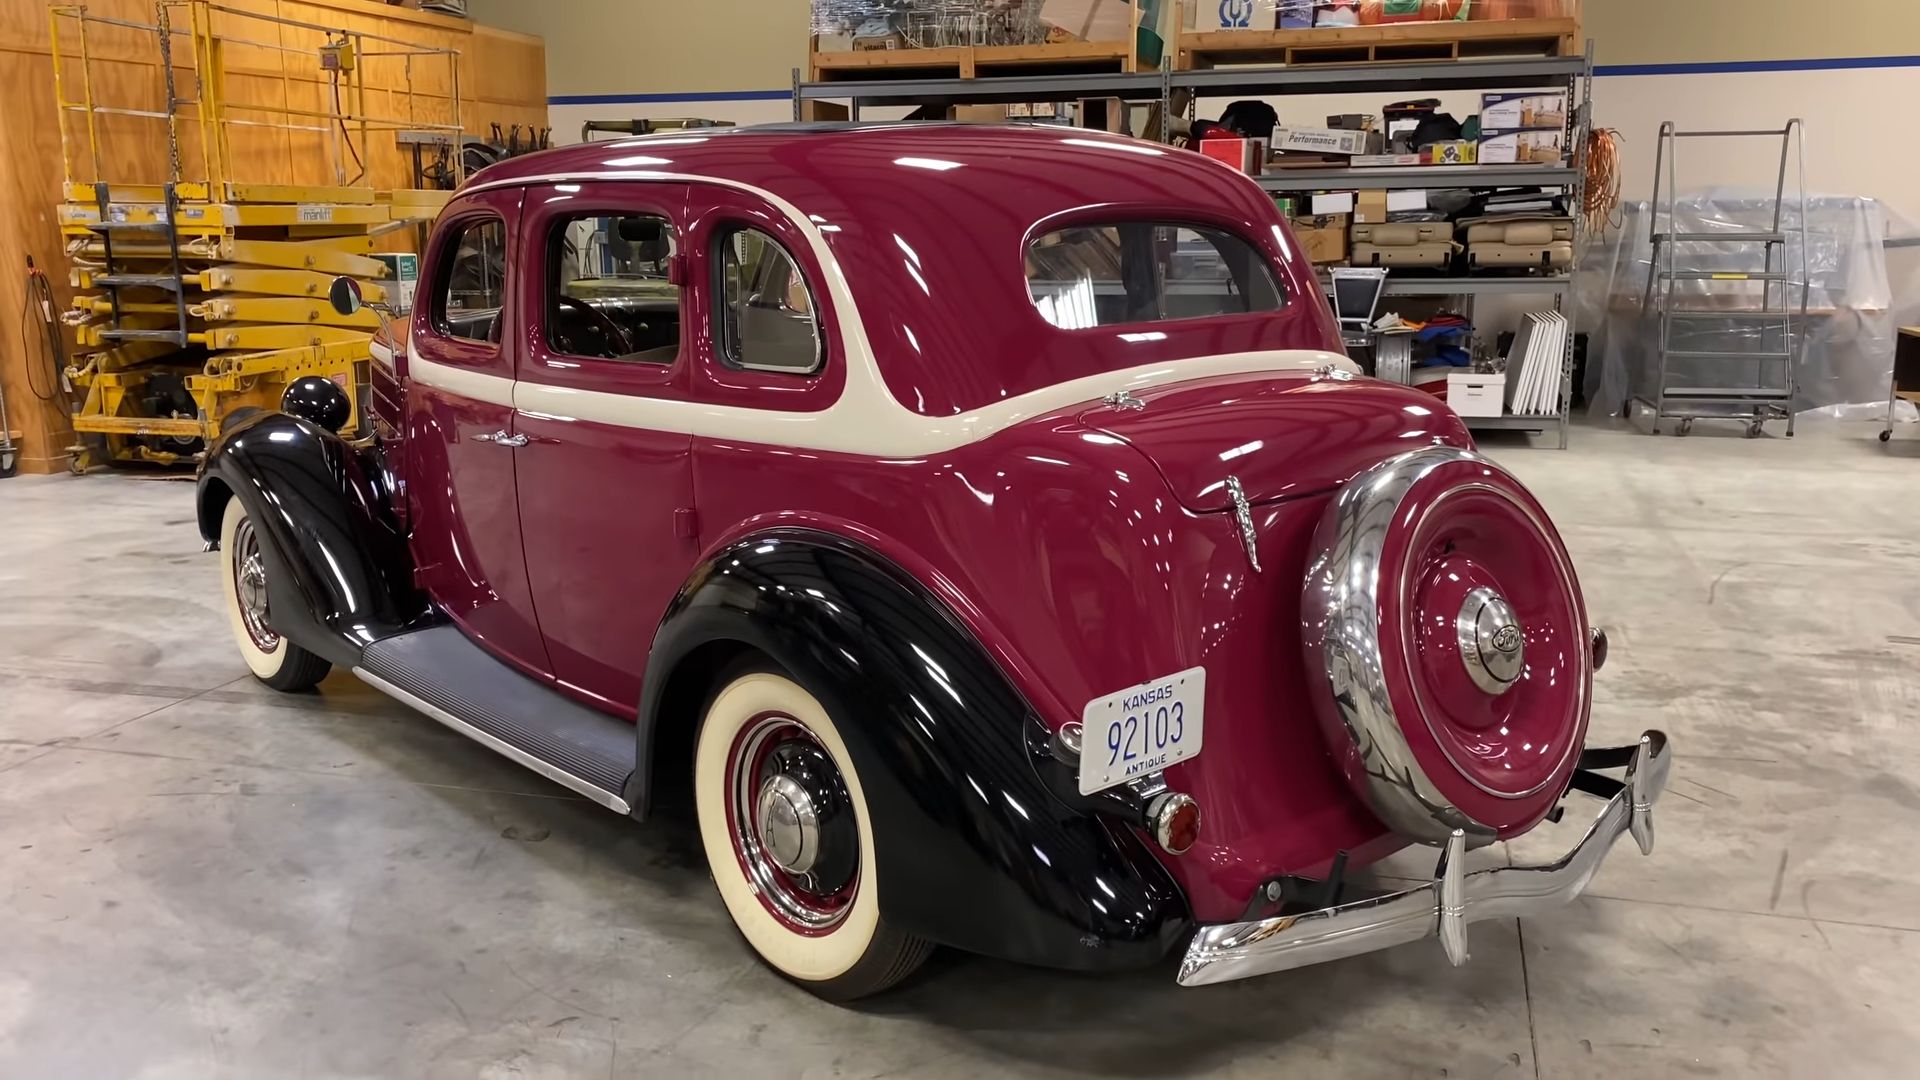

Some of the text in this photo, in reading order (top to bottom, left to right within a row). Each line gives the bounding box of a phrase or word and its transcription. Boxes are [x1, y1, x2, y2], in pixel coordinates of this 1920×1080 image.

[1288, 134, 1337, 145] Performance
[1123, 685, 1173, 712] KANSAS
[1107, 701, 1184, 766] 92103
[1125, 753, 1167, 776] ANTIQUE
